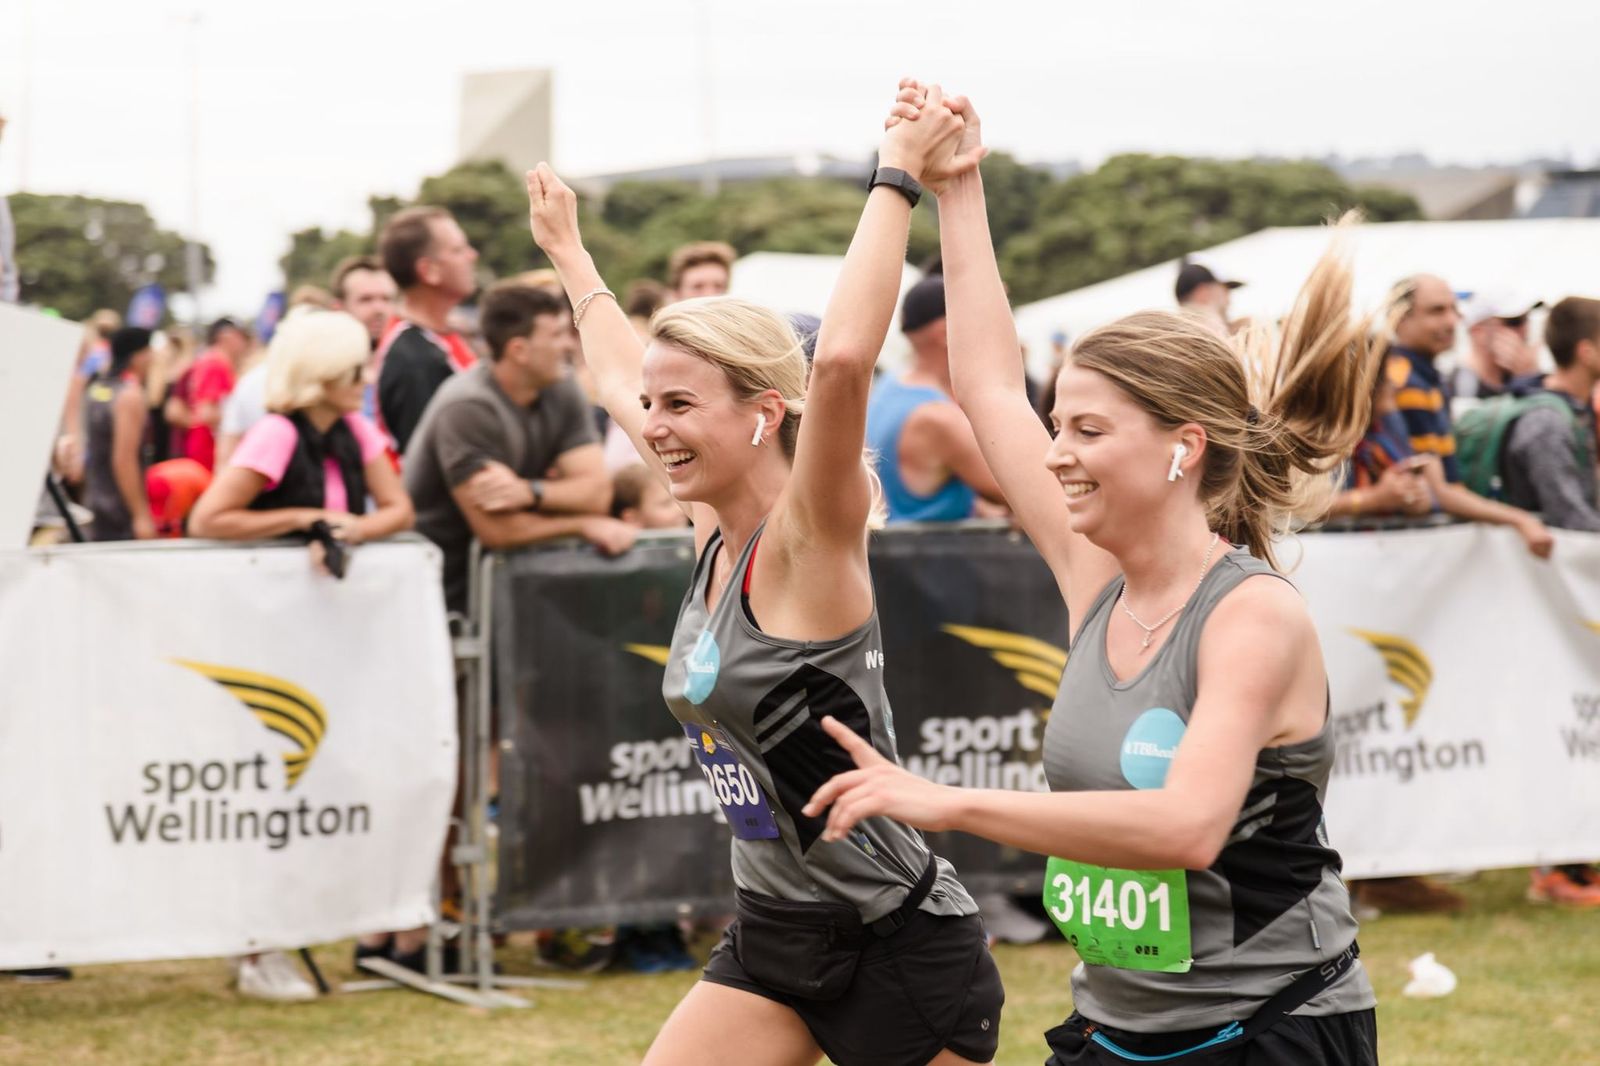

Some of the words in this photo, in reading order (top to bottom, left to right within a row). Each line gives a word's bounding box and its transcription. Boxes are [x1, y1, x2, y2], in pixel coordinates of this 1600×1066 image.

[609, 737, 692, 784] spor
[920, 708, 1041, 762] sport
[1333, 738, 1485, 783] llington
[142, 752, 269, 805] sport
[105, 797, 371, 850] Wellington
[1051, 872, 1171, 932] 31401
